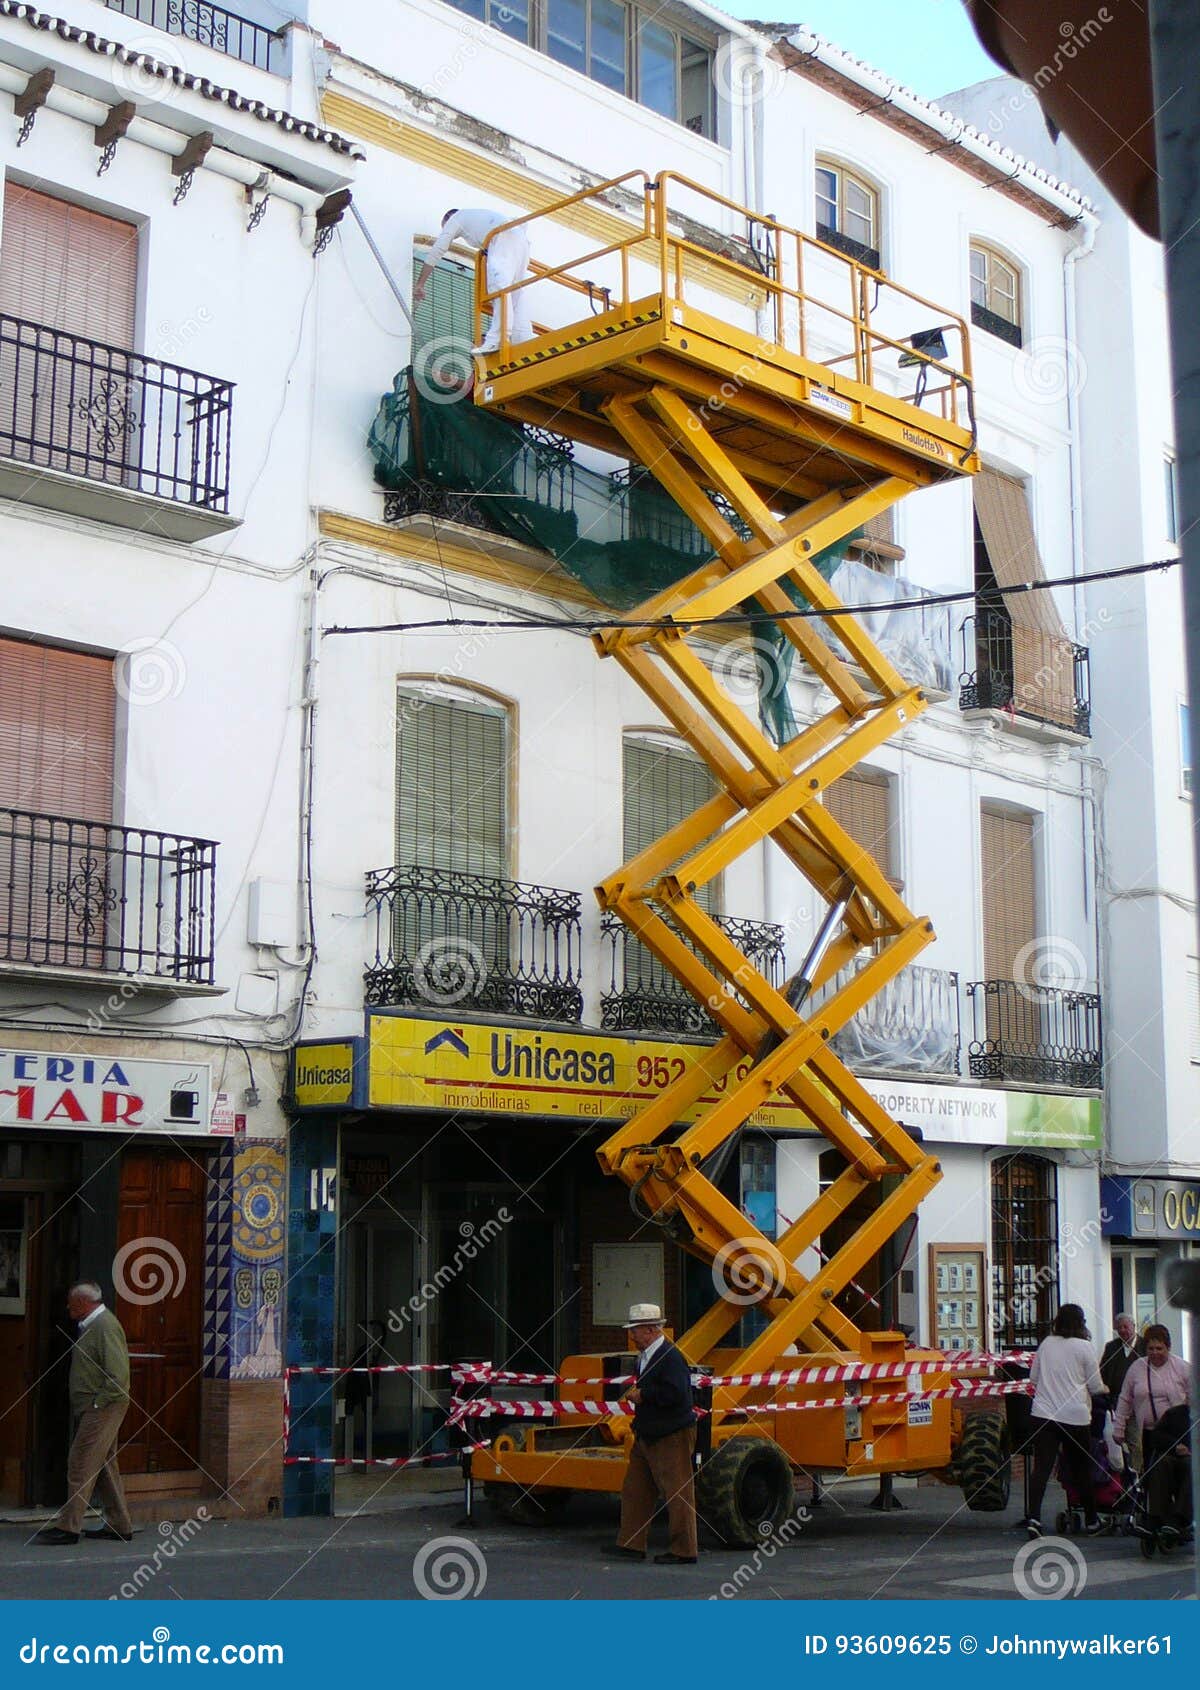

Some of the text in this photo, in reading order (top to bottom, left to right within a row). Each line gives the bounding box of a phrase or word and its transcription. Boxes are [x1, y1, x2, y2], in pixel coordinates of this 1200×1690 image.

[903, 429, 935, 452] Haulotte
[0, 1054, 130, 1087] ERIA
[491, 1032, 615, 1085] Unicasa
[298, 1066, 350, 1087] Unicasa
[444, 1092, 530, 1111] inmobiliarias
[579, 1099, 602, 1116] real
[620, 1104, 645, 1118] est
[939, 1098, 997, 1119] NETWORK
[1163, 1189, 1200, 1231] OC
